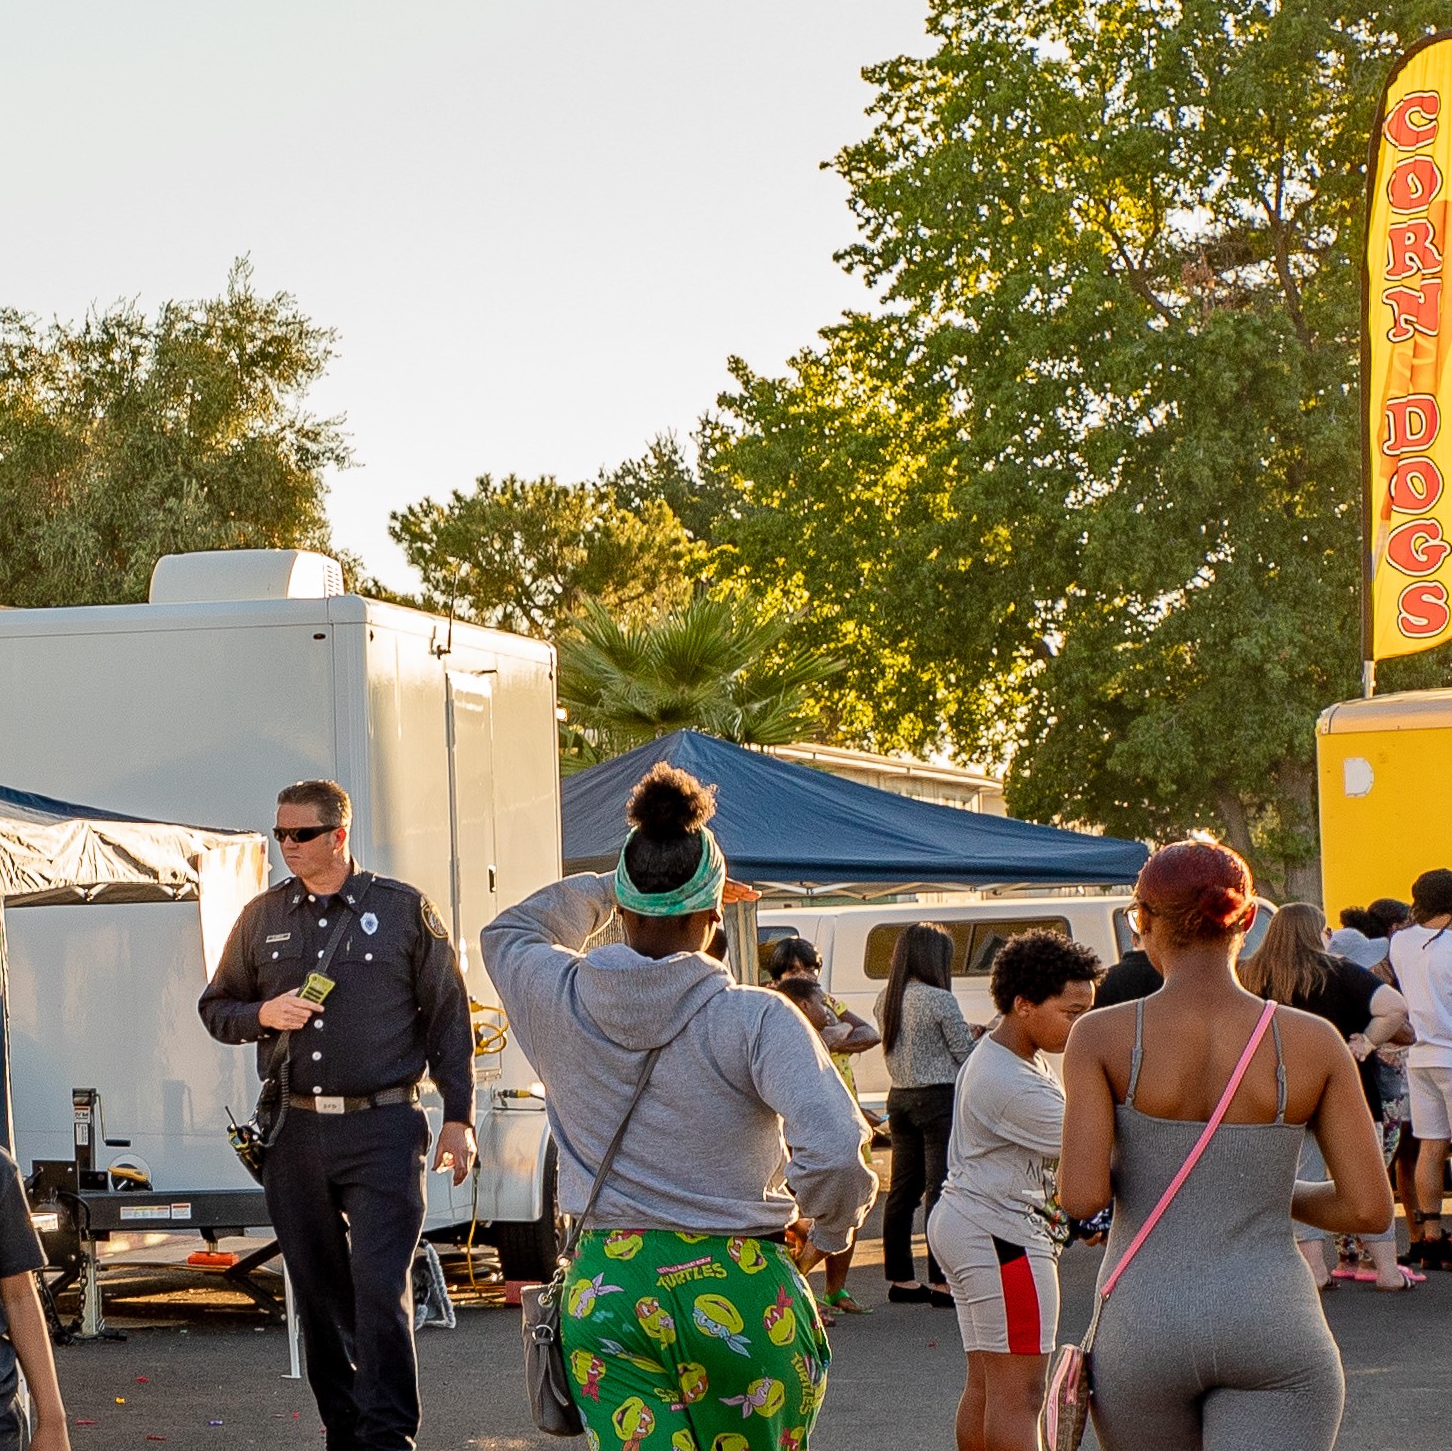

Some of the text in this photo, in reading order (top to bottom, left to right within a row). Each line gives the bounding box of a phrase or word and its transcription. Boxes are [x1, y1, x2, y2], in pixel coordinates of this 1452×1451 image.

[1383, 89, 1451, 640] CORN DOGS
[656, 1262, 727, 1292] TURTLES
[790, 1352, 813, 1415] TURTLES
